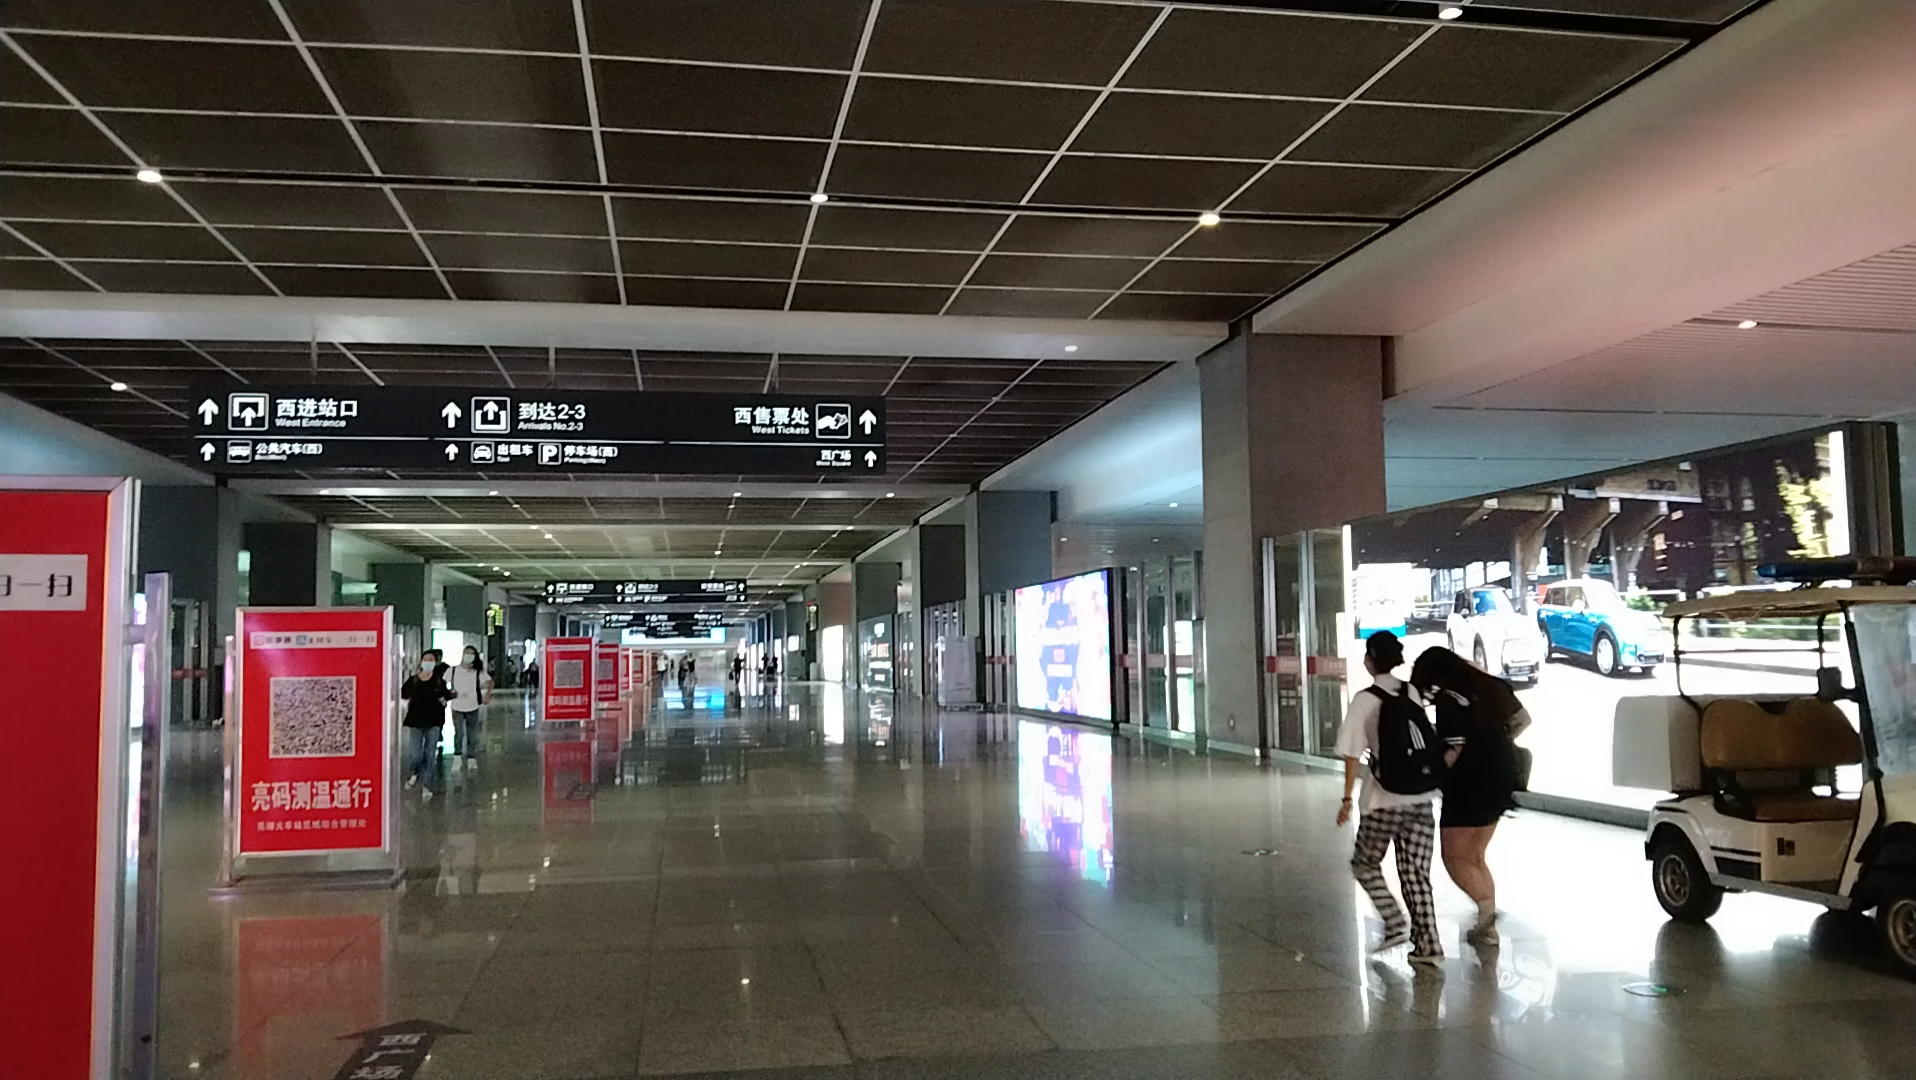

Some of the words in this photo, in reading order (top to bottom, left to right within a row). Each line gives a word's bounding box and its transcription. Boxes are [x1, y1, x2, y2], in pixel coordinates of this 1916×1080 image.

[276, 398, 358, 418] 西进站口
[517, 401, 587, 421] 到达2-3
[733, 406, 810, 425] 西售票处
[275, 418, 301, 428] West
[302, 418, 347, 428] Entrance
[517, 421, 552, 431] Arrivals
[553, 422, 584, 432] No.2-3
[751, 425, 775, 435] West
[777, 425, 810, 435] Tickets
[497, 443, 534, 456] 出租车
[563, 445, 618, 458] 停车场(西)
[820, 449, 852, 461] 西广场
[251, 778, 373, 812] 亮码测温通行
